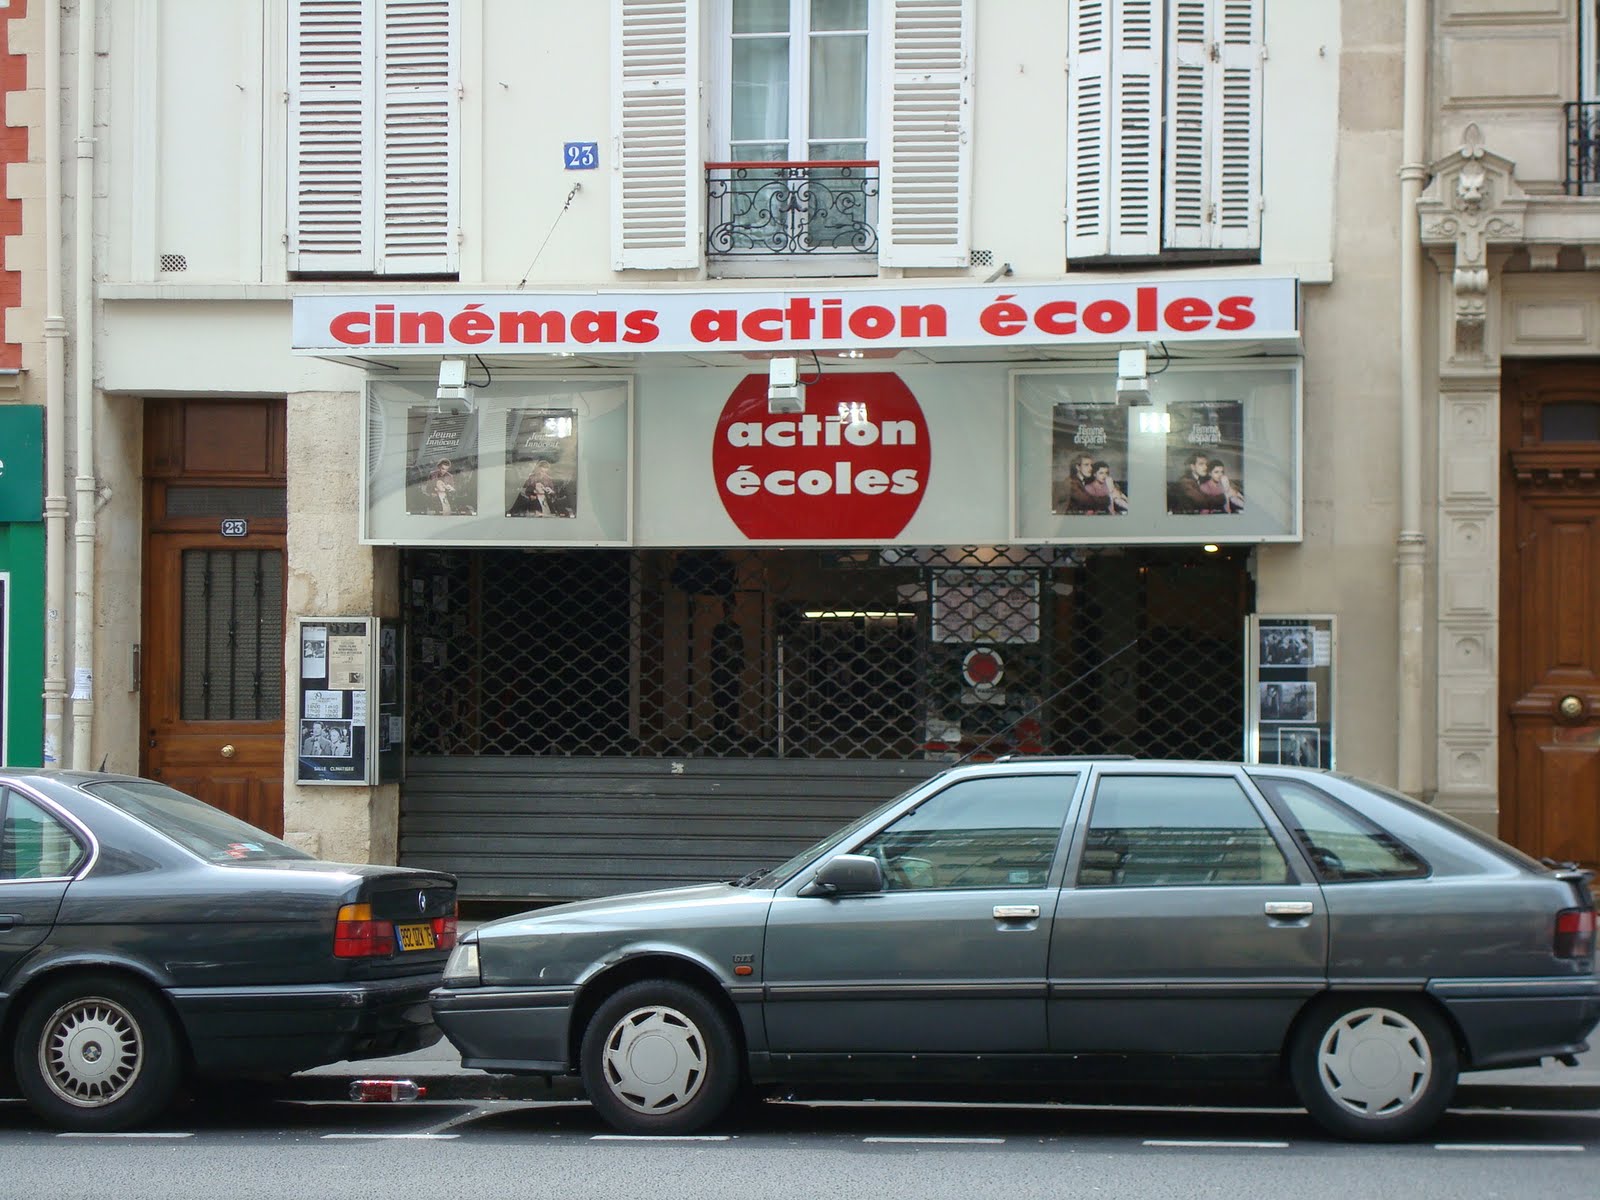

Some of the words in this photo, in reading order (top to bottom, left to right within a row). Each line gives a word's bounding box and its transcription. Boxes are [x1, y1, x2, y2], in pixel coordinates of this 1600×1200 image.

[567, 146, 594, 166] 23
[329, 303, 660, 345] cinémas
[690, 297, 947, 343] action
[979, 287, 1256, 337] écoles
[429, 430, 457, 439] Jeune
[727, 414, 916, 447] action
[425, 437, 460, 446] Innocent
[726, 461, 919, 496] écoles
[225, 521, 243, 534] 23
